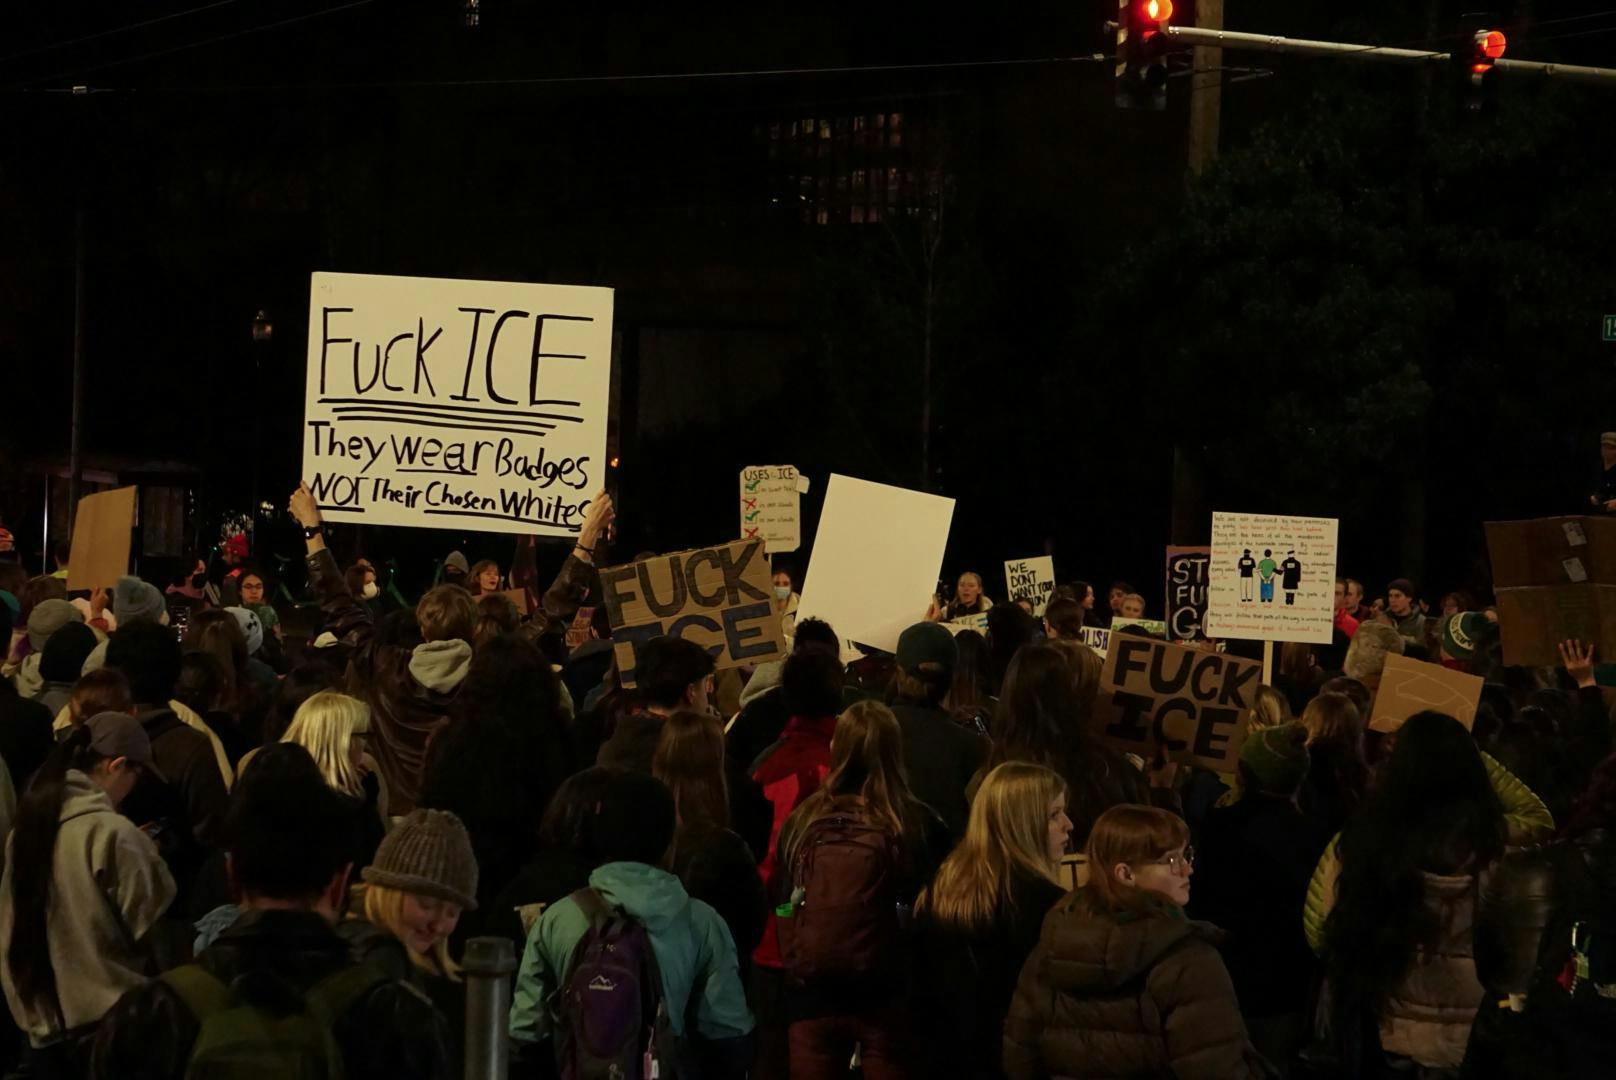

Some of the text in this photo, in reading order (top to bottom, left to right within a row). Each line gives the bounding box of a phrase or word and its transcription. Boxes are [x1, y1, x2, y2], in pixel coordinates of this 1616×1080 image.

[449, 307, 594, 407] ICE
[308, 420, 386, 474] They
[495, 438, 591, 489] Badges
[777, 467, 794, 480] ICE
[372, 477, 423, 508] Their
[424, 481, 496, 510] Chosen
[599, 542, 771, 628] FUCK
[1008, 562, 1028, 574] WE
[1172, 558, 1209, 584] ST
[1176, 584, 1208, 606] FU
[1172, 605, 1208, 640] G
[1113, 640, 1262, 709] FUCK
[1107, 690, 1239, 760] ICE
